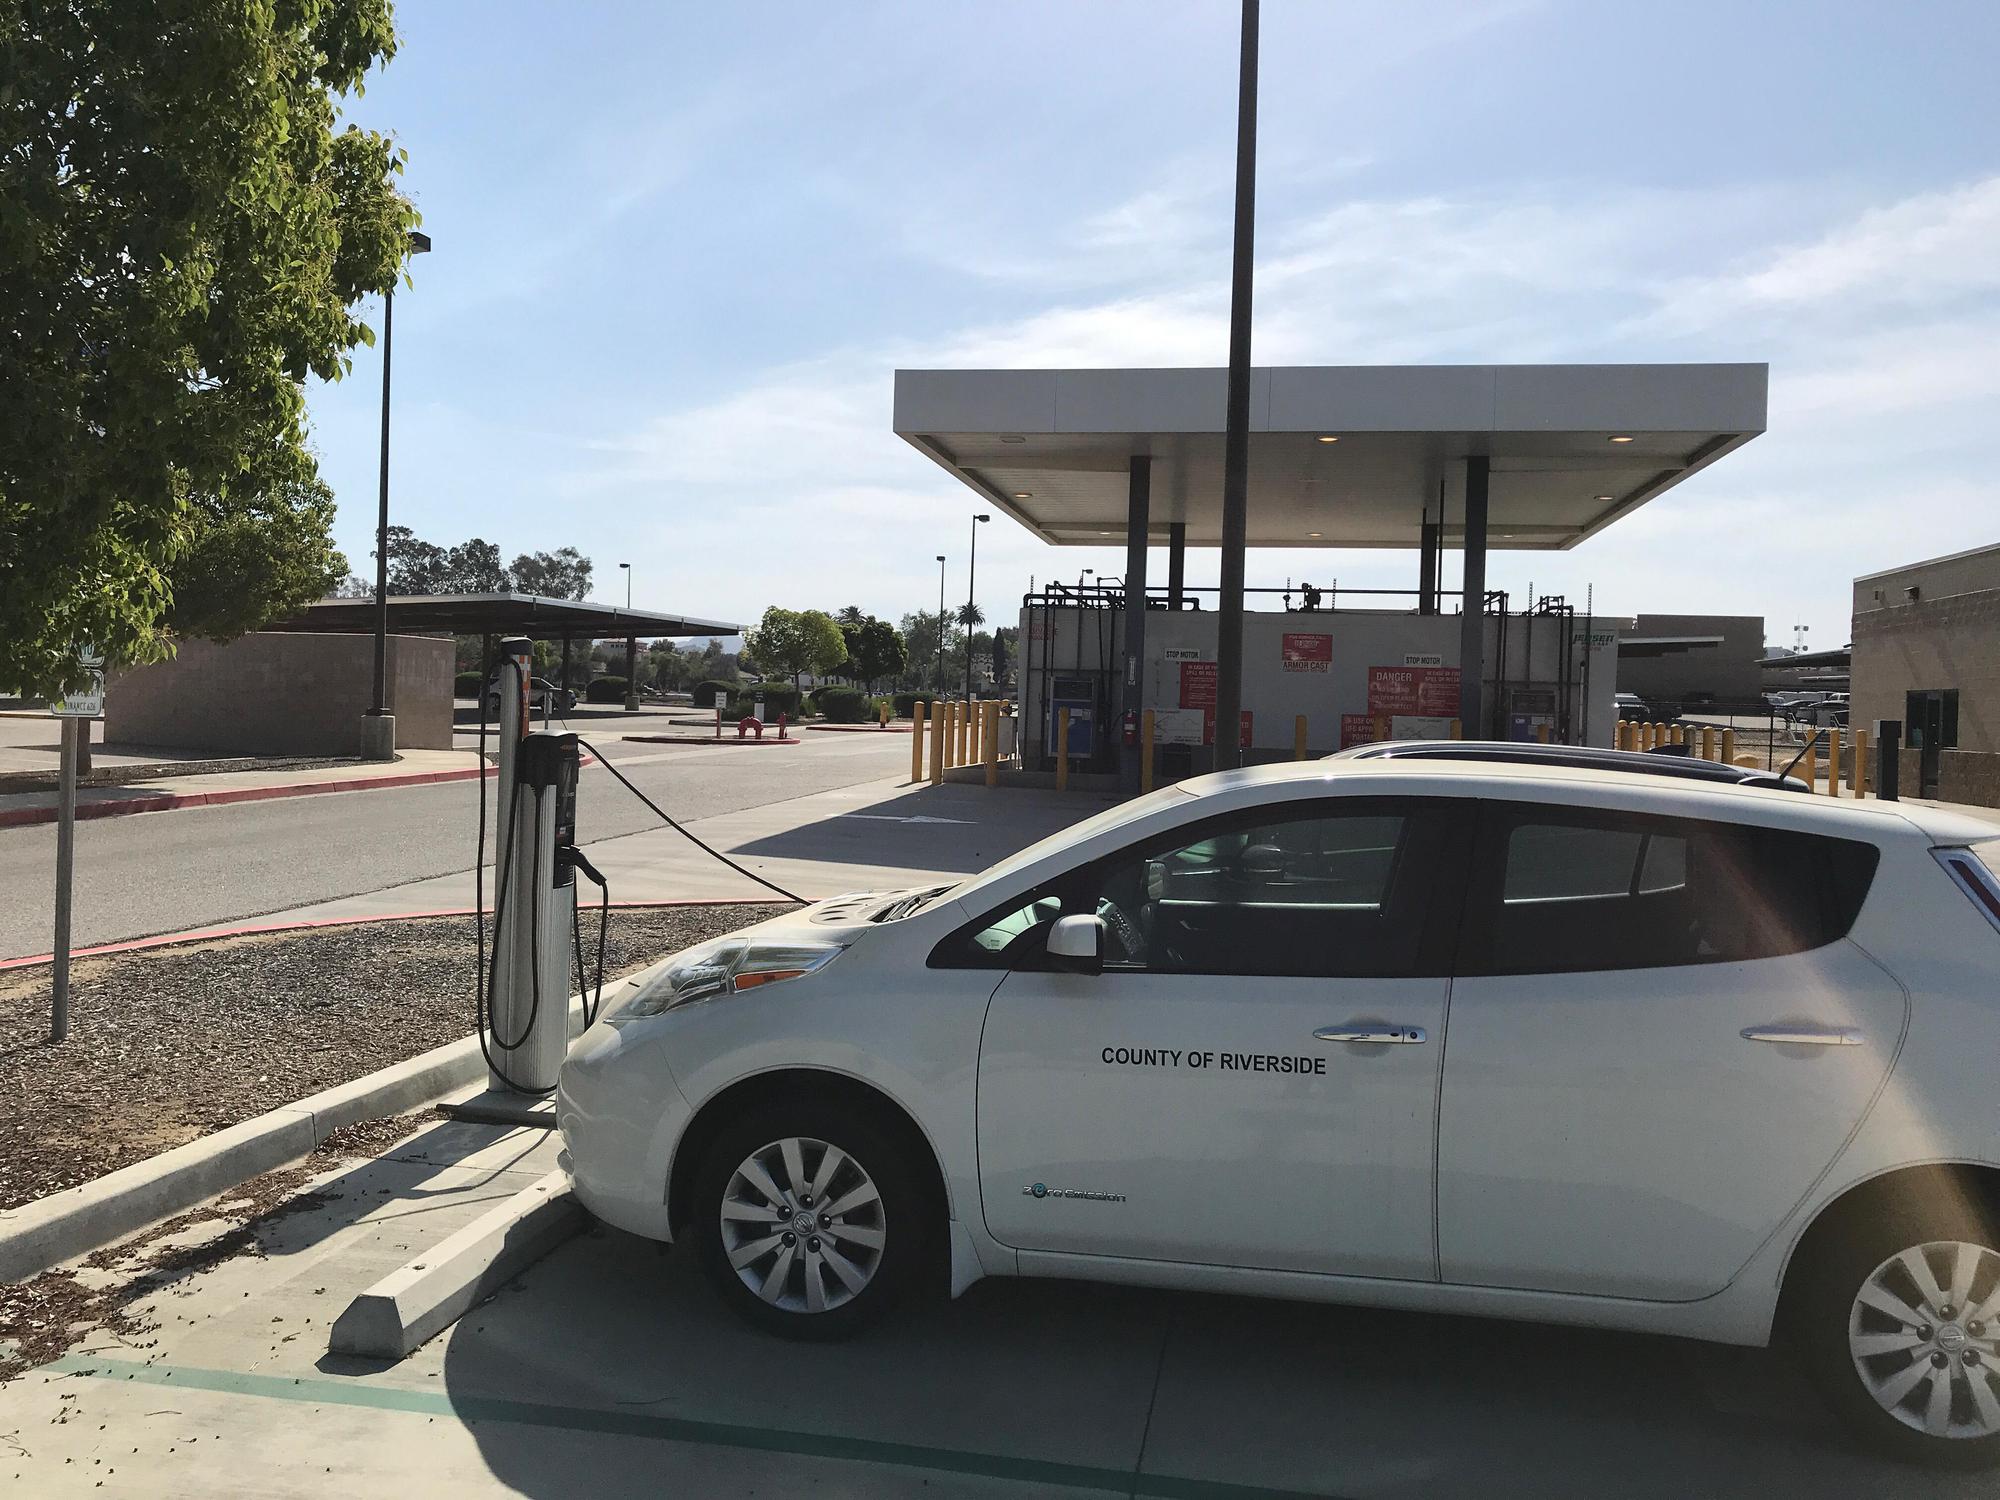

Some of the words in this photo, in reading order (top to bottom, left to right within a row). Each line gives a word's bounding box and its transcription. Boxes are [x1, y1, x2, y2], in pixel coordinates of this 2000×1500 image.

[1166, 650, 1180, 658] STOP
[1181, 651, 1199, 659] MOTOR
[1406, 656, 1420, 664] STOP
[1421, 657, 1440, 665] MOTOR
[1310, 662, 1330, 670] CAST
[1376, 672, 1412, 682] DANGER
[1101, 1047, 1183, 1067] COUNTY
[1187, 1051, 1214, 1068] OF
[1220, 1052, 1327, 1075] RIVERSIDE
